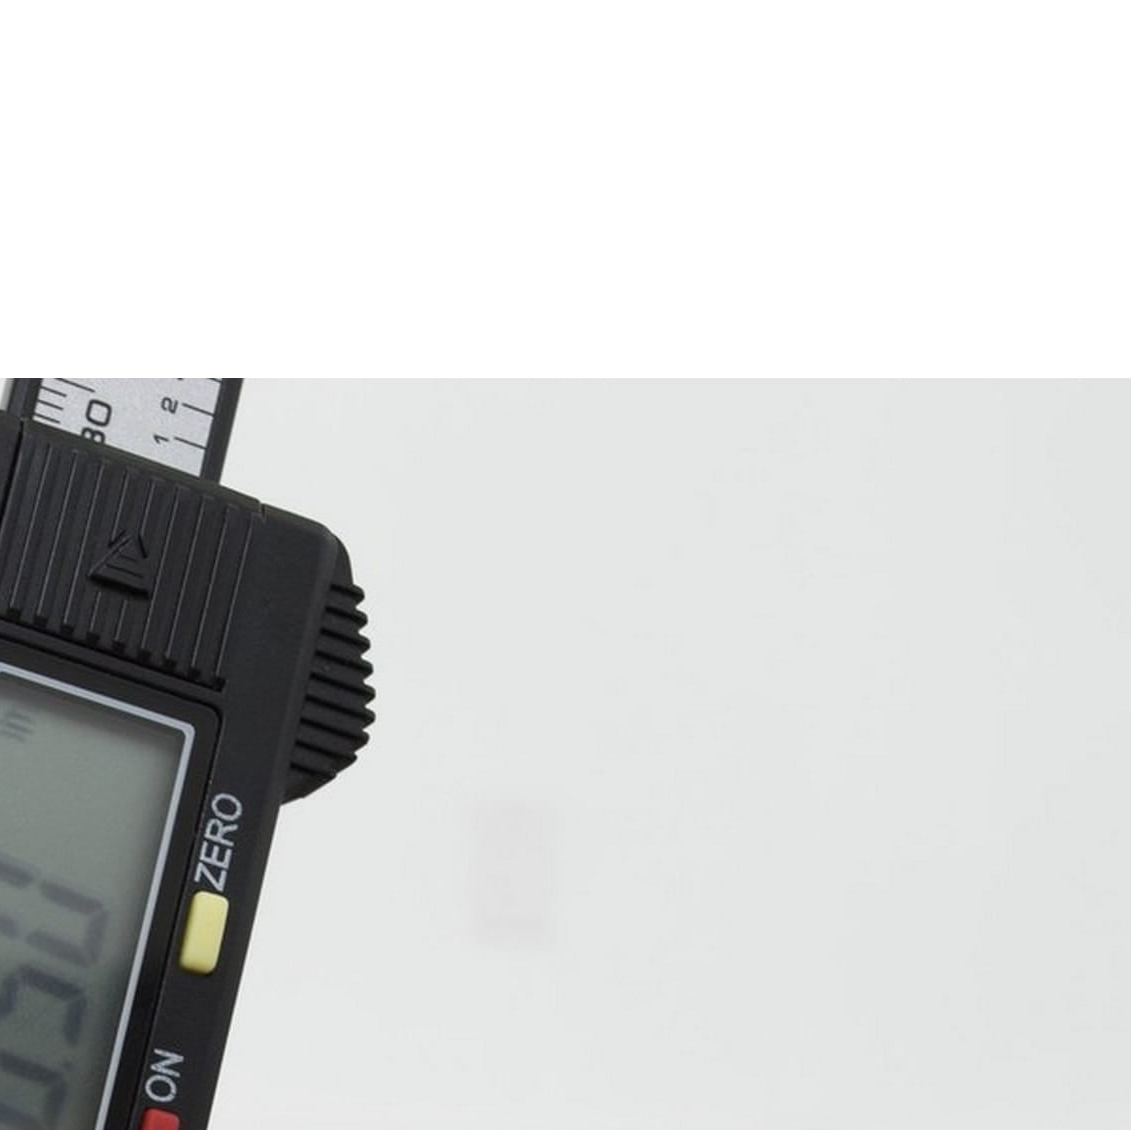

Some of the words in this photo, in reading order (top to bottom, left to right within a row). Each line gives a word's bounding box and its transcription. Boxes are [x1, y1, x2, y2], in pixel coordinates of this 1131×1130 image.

[160, 397, 178, 414] 2
[153, 433, 169, 444] 1
[193, 793, 243, 892] ZERO
[145, 1048, 184, 1102] ON
